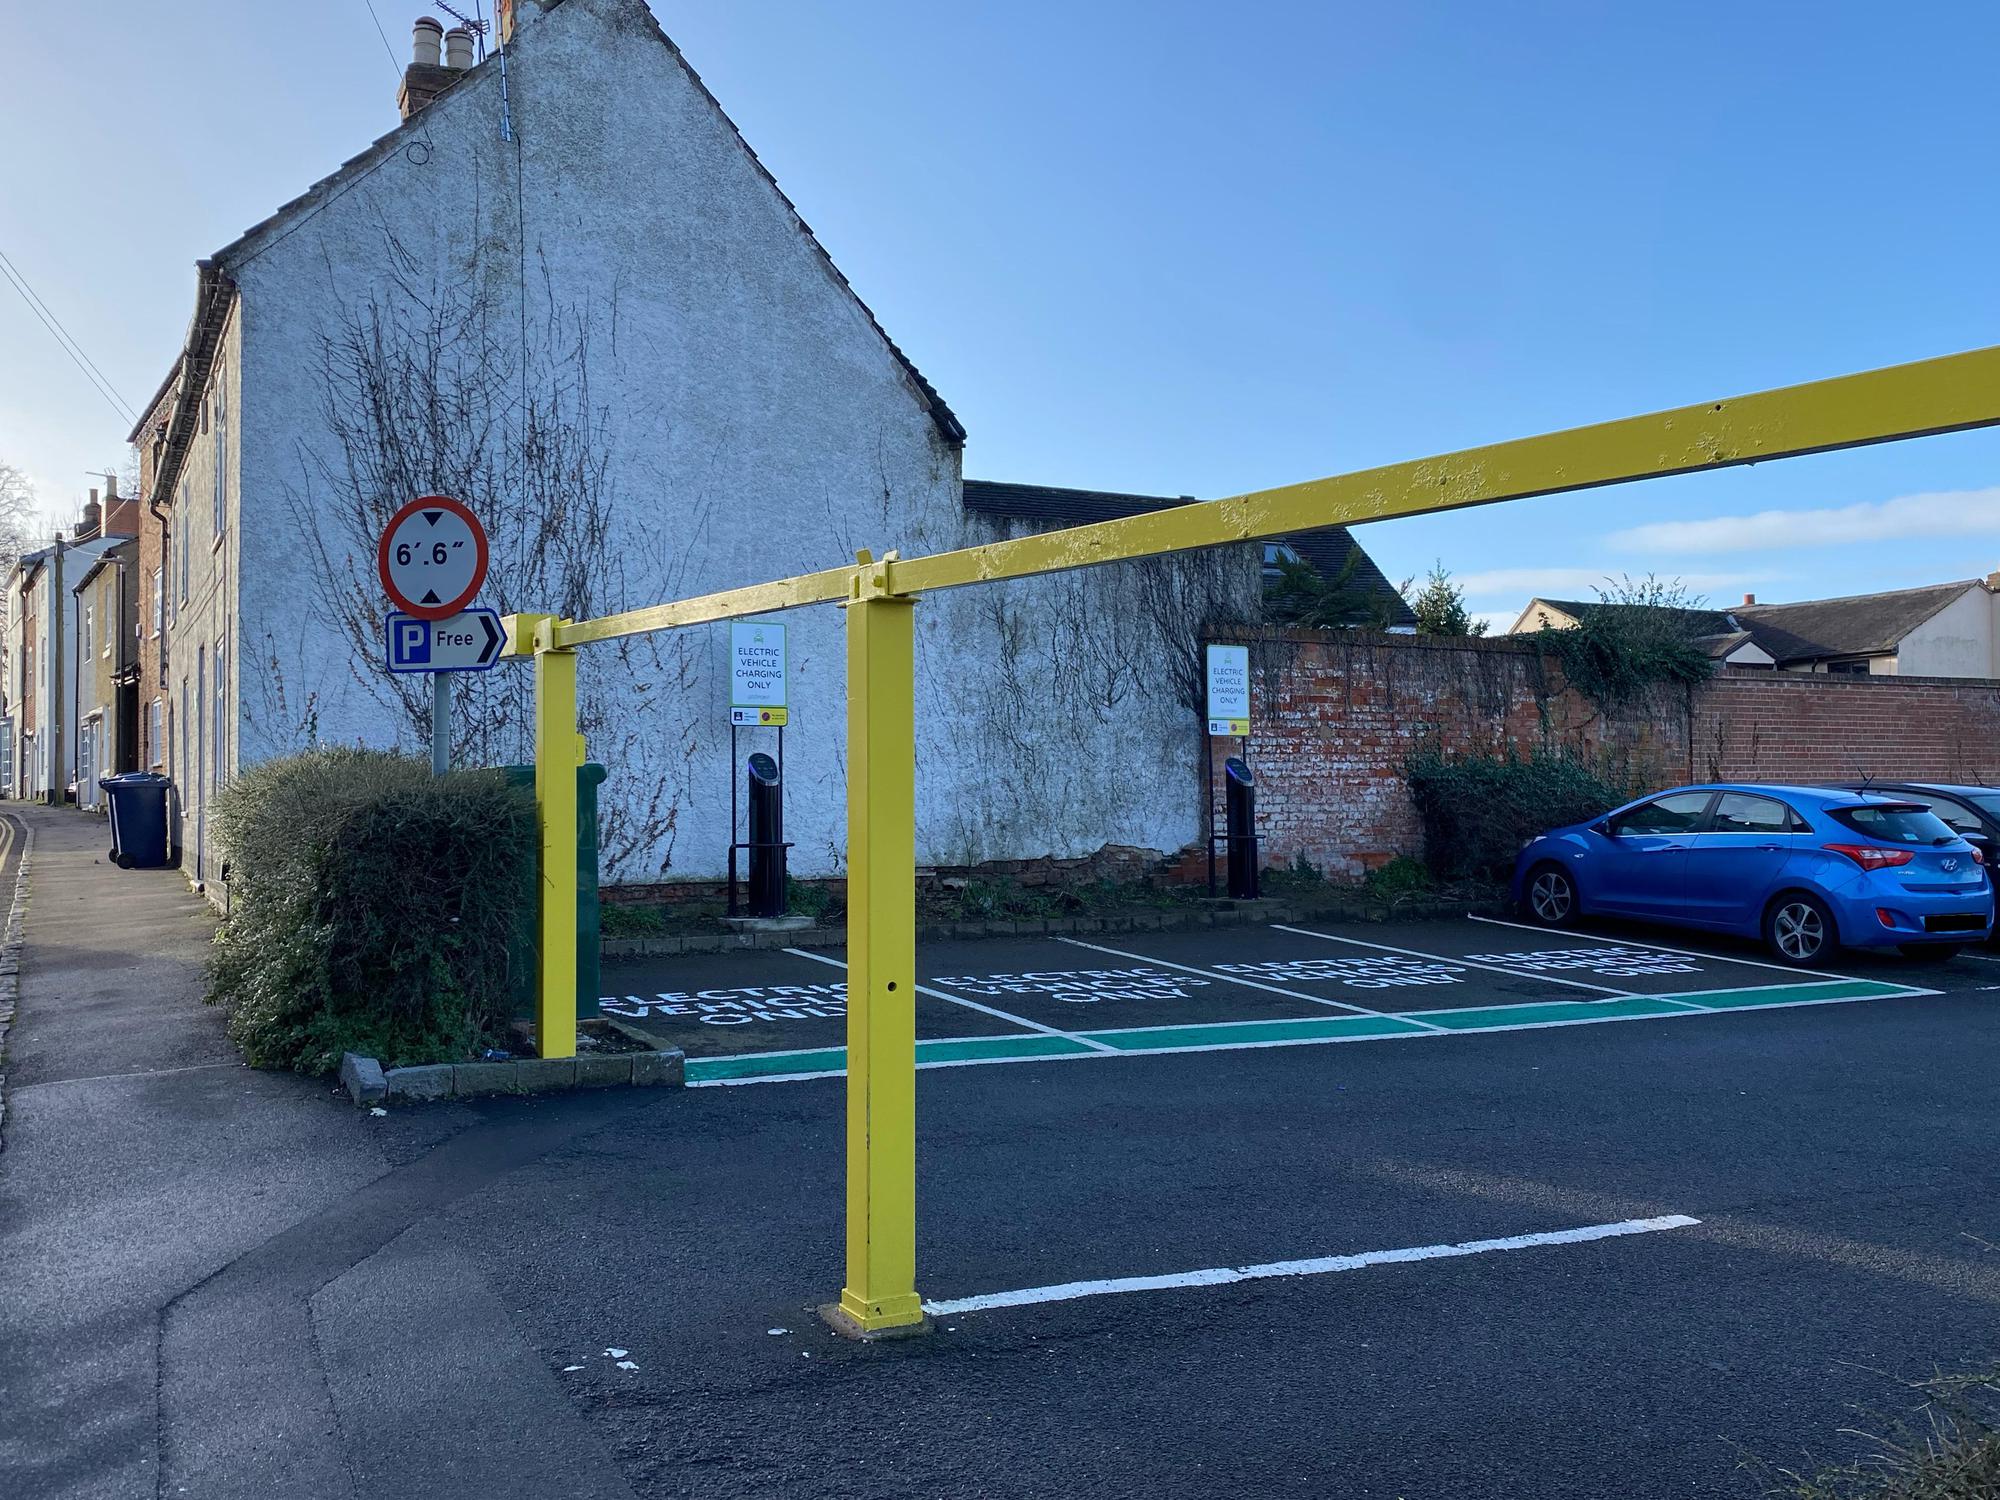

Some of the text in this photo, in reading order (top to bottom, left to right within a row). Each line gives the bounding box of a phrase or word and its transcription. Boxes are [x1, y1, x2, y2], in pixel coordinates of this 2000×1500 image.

[402, 624, 473, 660] P Free
[738, 647, 780, 656] ELECTRIC
[741, 659, 777, 667] VEHICLE
[736, 669, 782, 679] CHARGING
[1213, 667, 1243, 676] ELECTRIC
[747, 680, 771, 689] ONLY
[1211, 687, 1245, 695] CHARGING
[1464, 947, 1649, 962] ELECTRIC
[1211, 956, 1422, 973] ELECTRIC
[1503, 954, 1696, 970] VEHICLES
[1244, 964, 1466, 980] VEHICLES
[1592, 963, 1704, 976] ONLY
[930, 968, 1170, 986] ELECTRIC
[1342, 974, 1465, 988] ONLY
[958, 976, 1211, 995] VEHICLES
[1052, 988, 1193, 1003] ONLY
